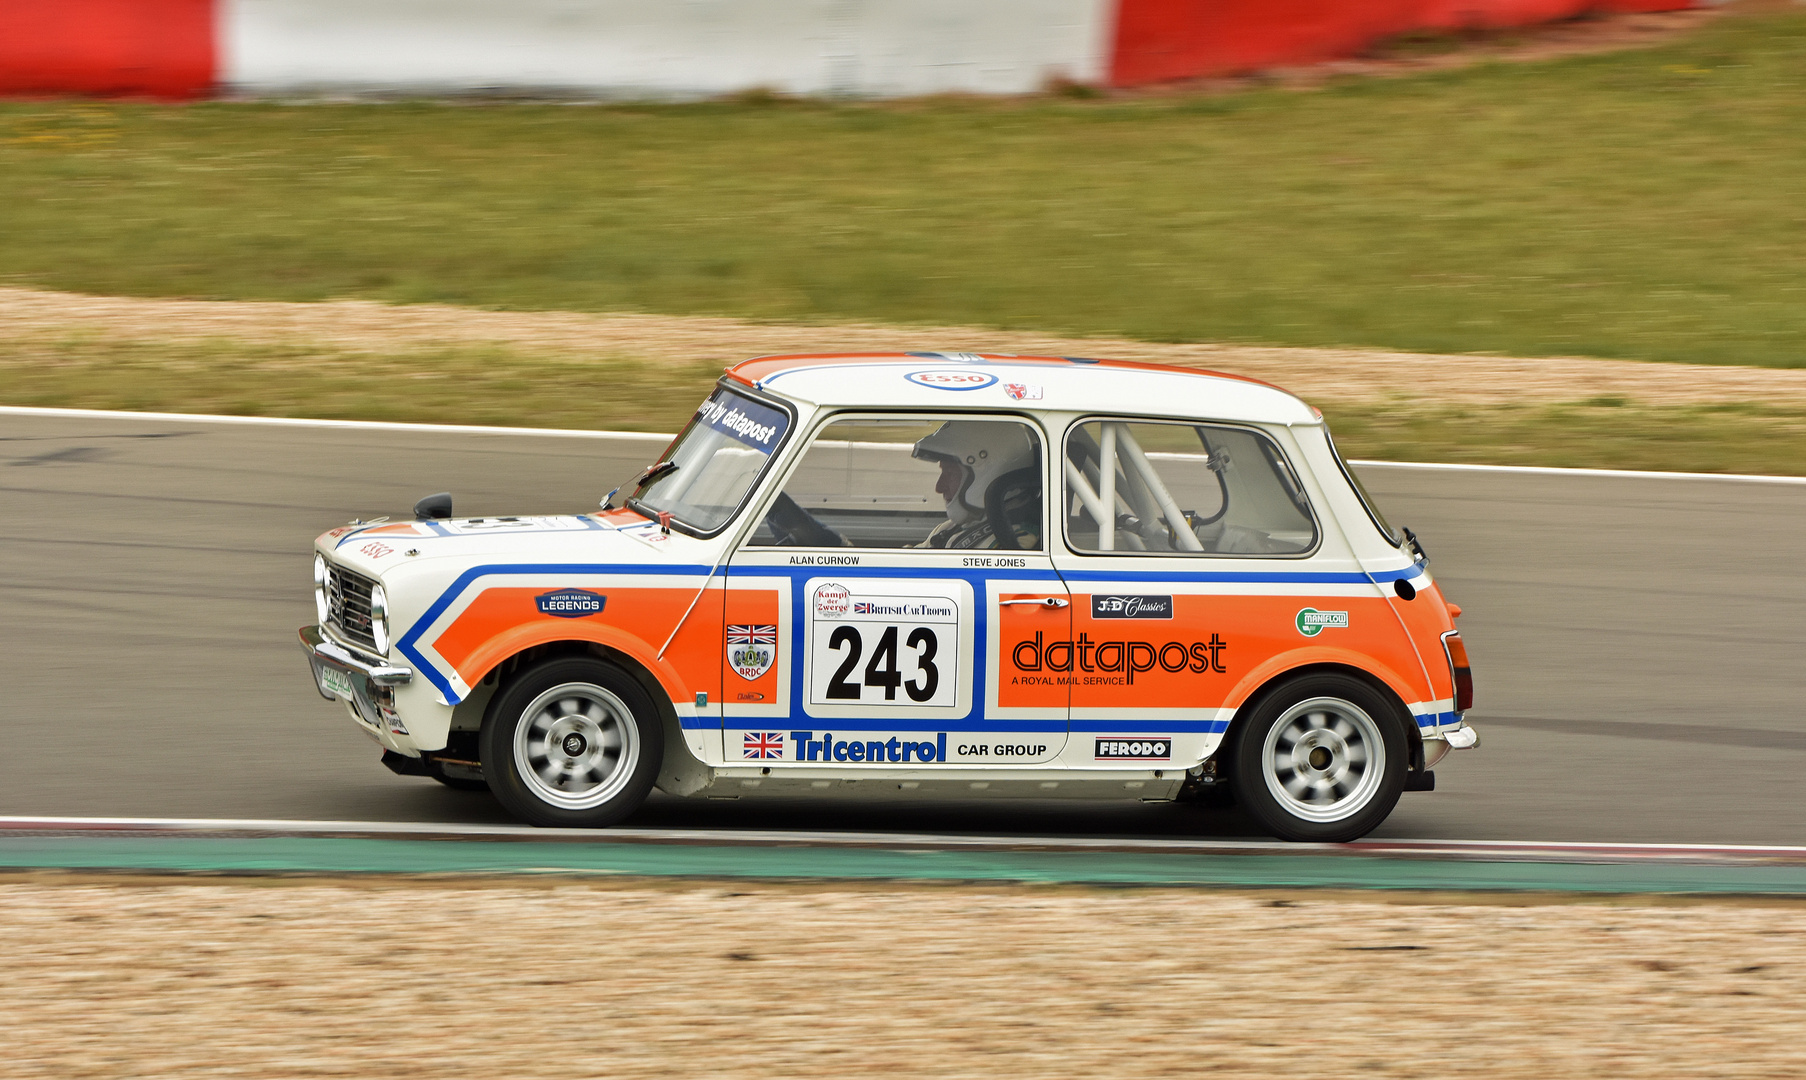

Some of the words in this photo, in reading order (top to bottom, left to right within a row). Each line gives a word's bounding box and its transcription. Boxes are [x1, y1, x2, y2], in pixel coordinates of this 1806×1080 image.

[711, 401, 728, 424] by
[722, 407, 777, 445] datapost
[789, 556, 815, 565] ALAN
[817, 556, 860, 565] CURNOW
[963, 557, 992, 567] STEVE
[994, 558, 1026, 568] JONES
[818, 590, 848, 600] Kampf
[542, 601, 600, 610] LEGENDS
[818, 603, 848, 613] Zwerge
[1124, 597, 1167, 617] Classics
[826, 625, 939, 702] 243
[1012, 631, 1227, 685] datapost
[739, 667, 762, 678] BRDC
[1011, 677, 1019, 685] A
[1021, 677, 1054, 685] ROYAL
[1057, 677, 1080, 685] MAIL
[1083, 677, 1125, 685] SERVICE
[790, 731, 947, 762] Tricentrol
[957, 744, 988, 756] CAR
[993, 744, 1047, 756] GROUP
[1100, 742, 1166, 755] FERODO
